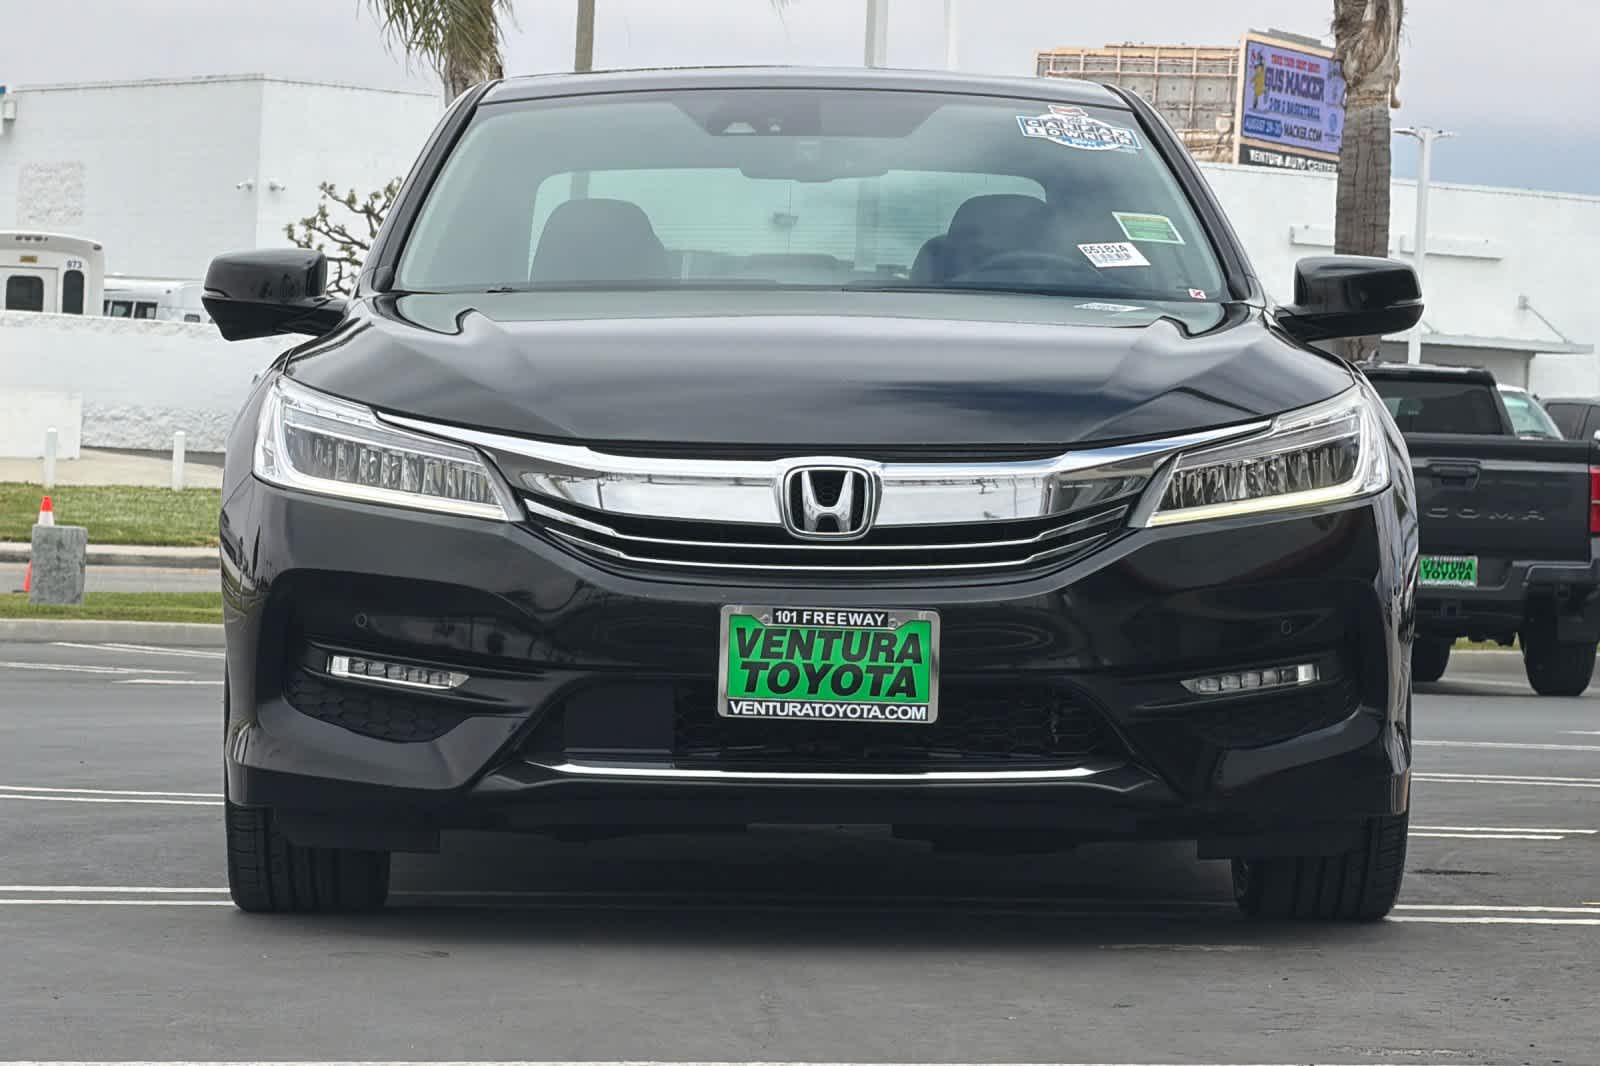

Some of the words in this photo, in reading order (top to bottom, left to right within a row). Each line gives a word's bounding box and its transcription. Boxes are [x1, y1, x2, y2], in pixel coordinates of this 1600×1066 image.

[1249, 150, 1283, 166] VENTURA
[1285, 155, 1306, 170] AUTO
[66, 260, 83, 269] 973
[1423, 560, 1473, 571] VENTURA
[1424, 570, 1471, 580] TOYOTA
[775, 611, 797, 624] 101
[802, 611, 885, 626] FREEWAY
[736, 628, 923, 664] VENTURA
[741, 661, 917, 698] TOYOTA
[730, 700, 927, 720] VENTURATOYOTA.COM
